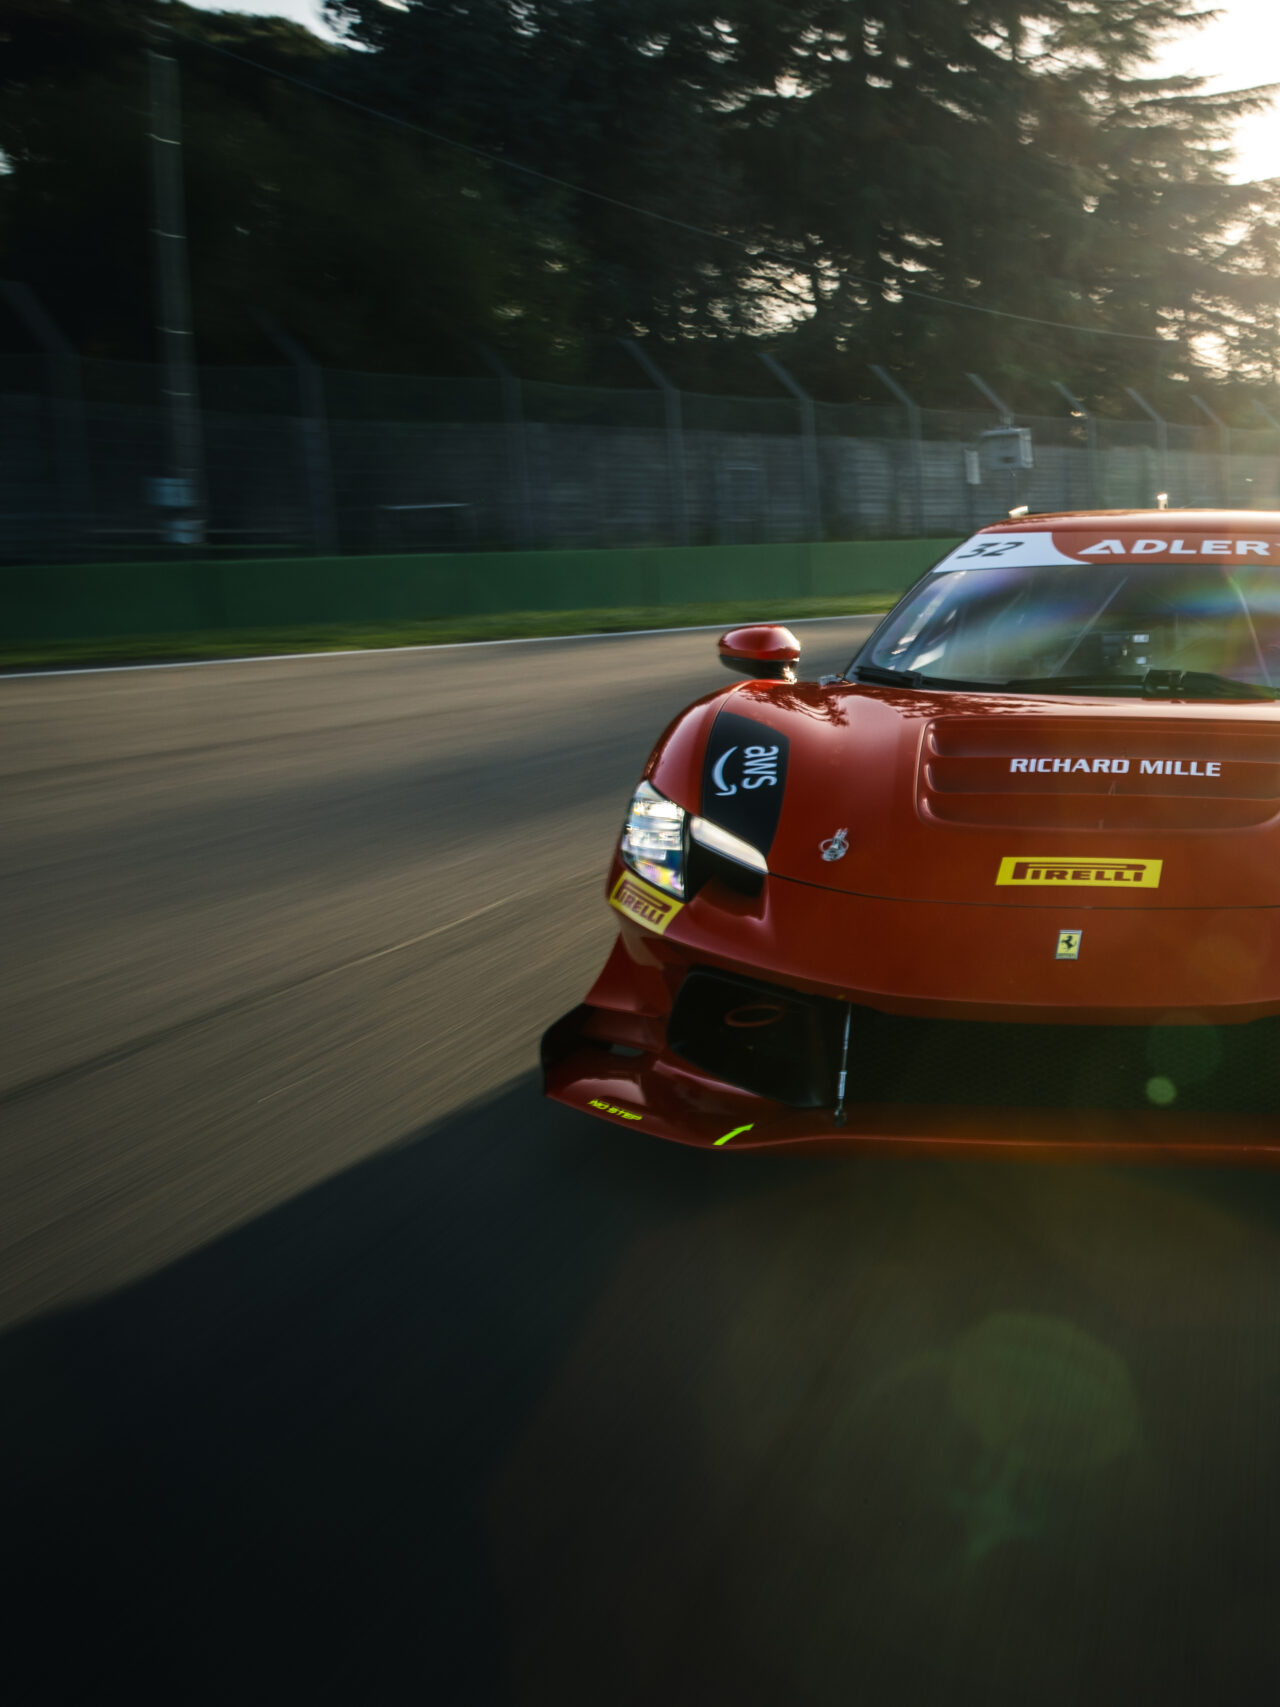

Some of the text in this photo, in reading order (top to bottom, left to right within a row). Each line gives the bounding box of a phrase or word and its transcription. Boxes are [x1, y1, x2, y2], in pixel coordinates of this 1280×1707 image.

[957, 542, 1024, 559] 32
[1077, 539, 1270, 556] ADLER
[741, 745, 779, 790] aws
[1010, 758, 1222, 777] RICHARD MILLE
[1012, 862, 1146, 882] PIRELLI
[614, 879, 673, 925] PIRELLI
[587, 1099, 609, 1110] NO
